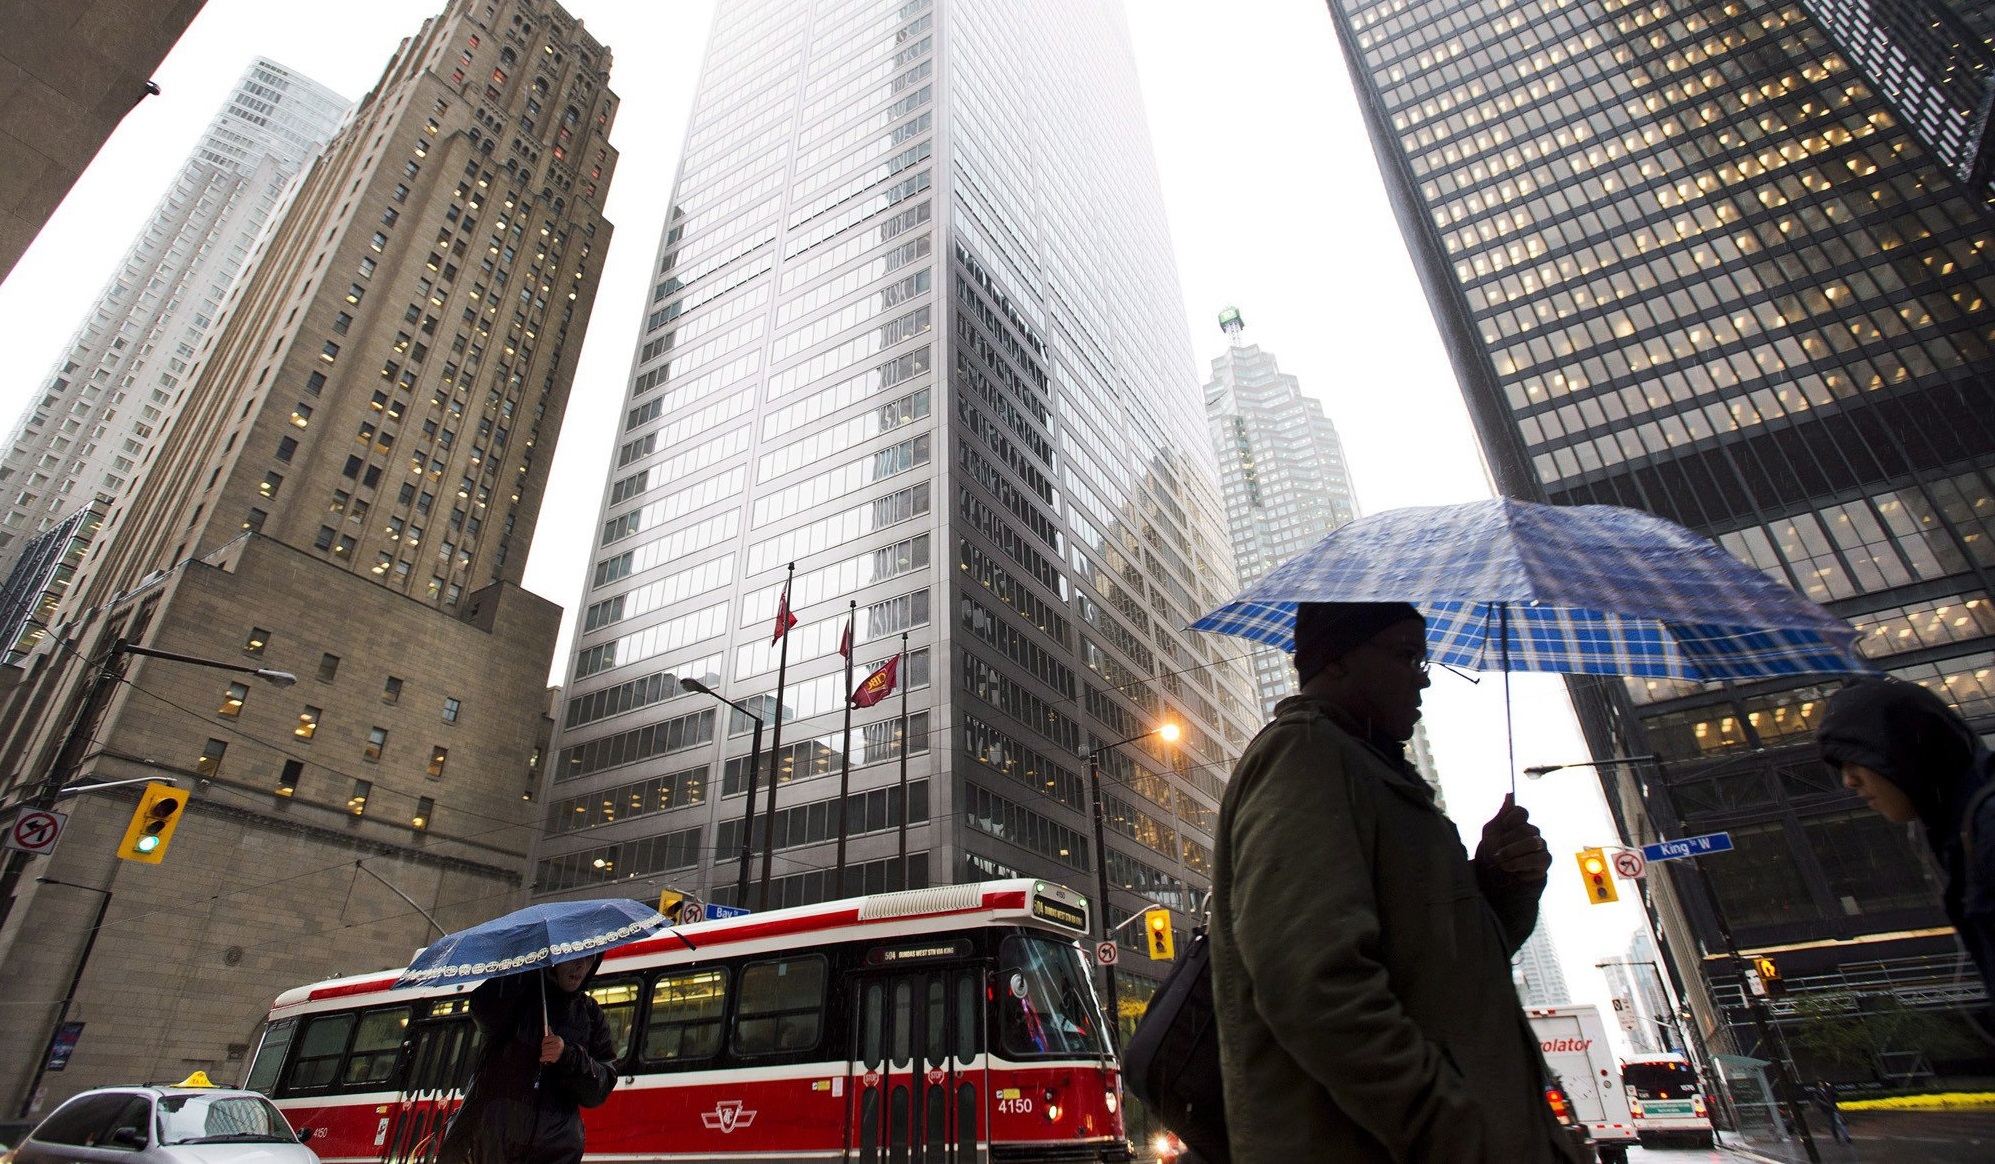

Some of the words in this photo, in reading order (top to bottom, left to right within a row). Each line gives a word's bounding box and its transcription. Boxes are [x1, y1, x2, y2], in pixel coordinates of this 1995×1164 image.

[1660, 843, 1690, 856] King
[1698, 837, 1711, 849] W
[716, 907, 733, 919] Bay
[884, 951, 896, 960] 504
[898, 950, 915, 959] DUNDAS
[916, 949, 928, 957] WEST
[928, 948, 936, 956] STN
[866, 1073, 877, 1081] STOP
[930, 1071, 942, 1079] STOP
[998, 1098, 1033, 1114] 4150
[313, 1127, 328, 1138] 4150
